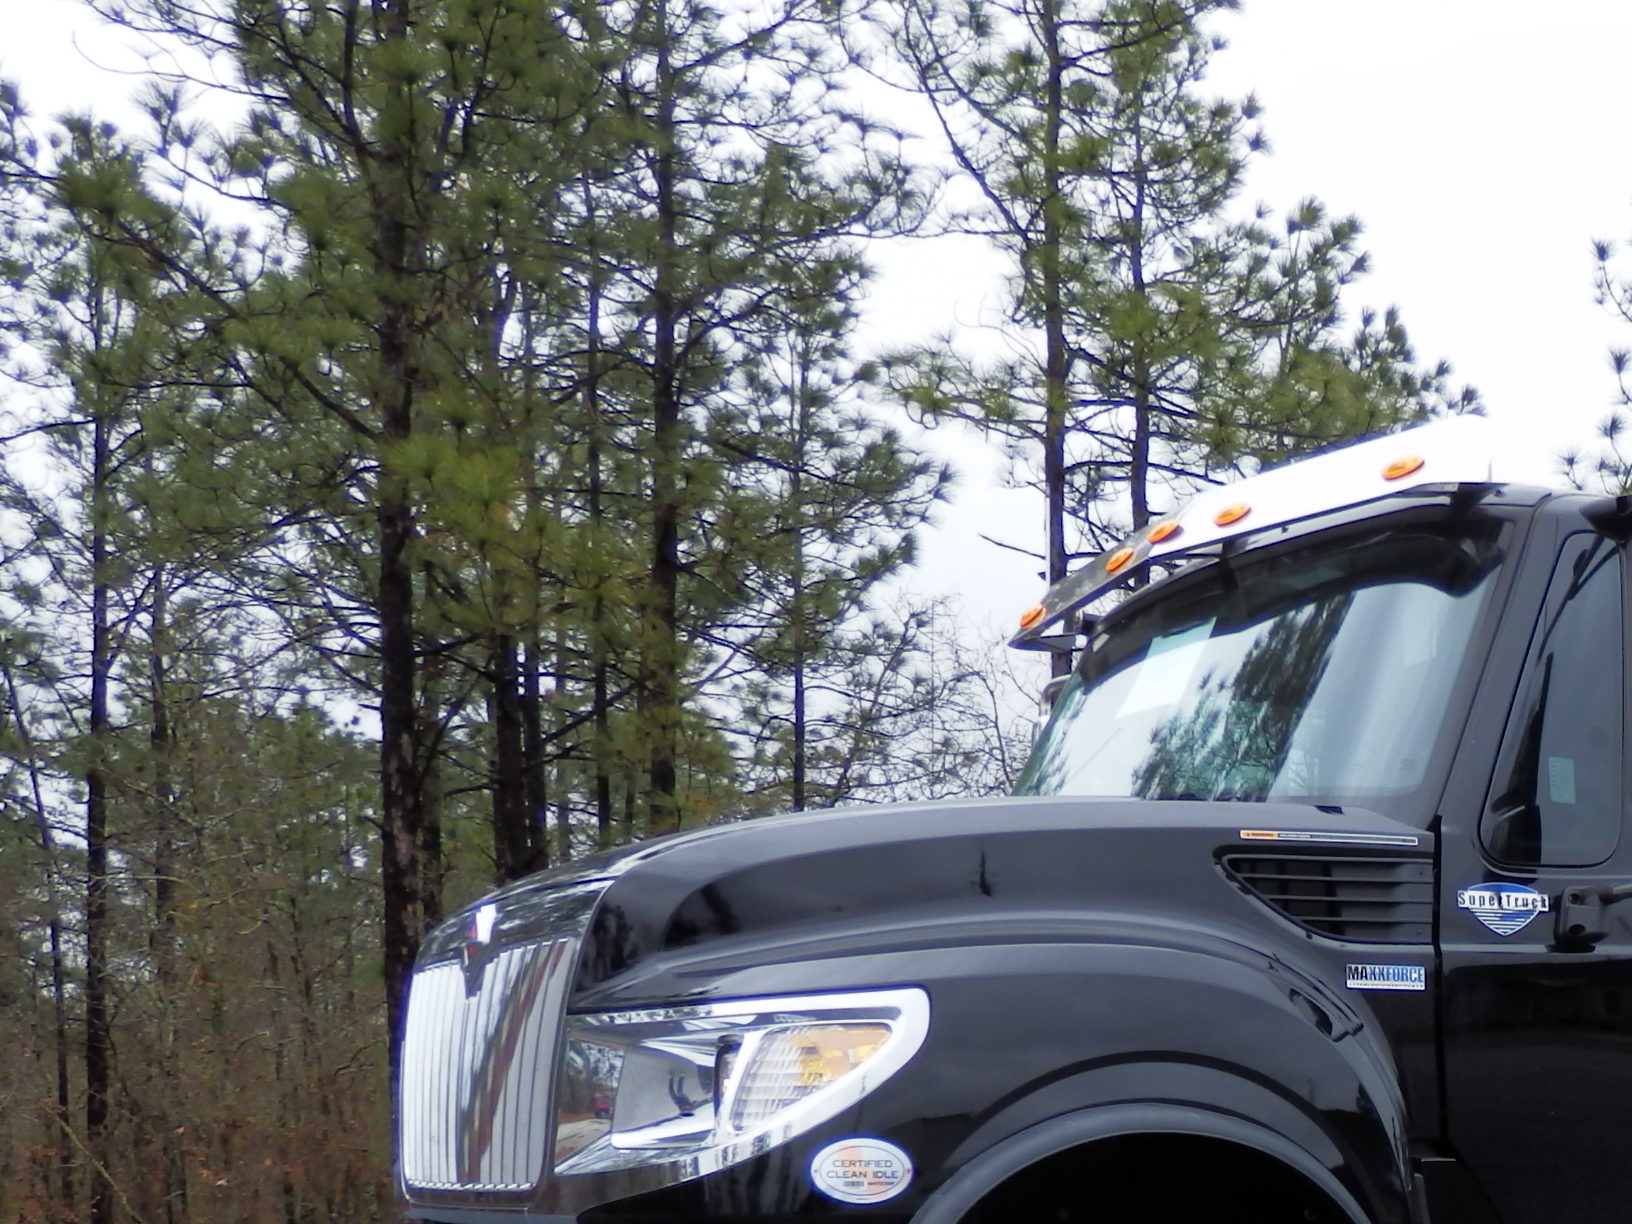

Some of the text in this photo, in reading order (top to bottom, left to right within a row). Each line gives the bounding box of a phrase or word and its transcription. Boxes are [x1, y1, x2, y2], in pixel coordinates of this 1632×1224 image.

[1347, 965, 1424, 983] MAXXFORCE
[832, 1159, 894, 1169] CERTIFIED
[826, 1170, 899, 1179] CLEAN IDLE
